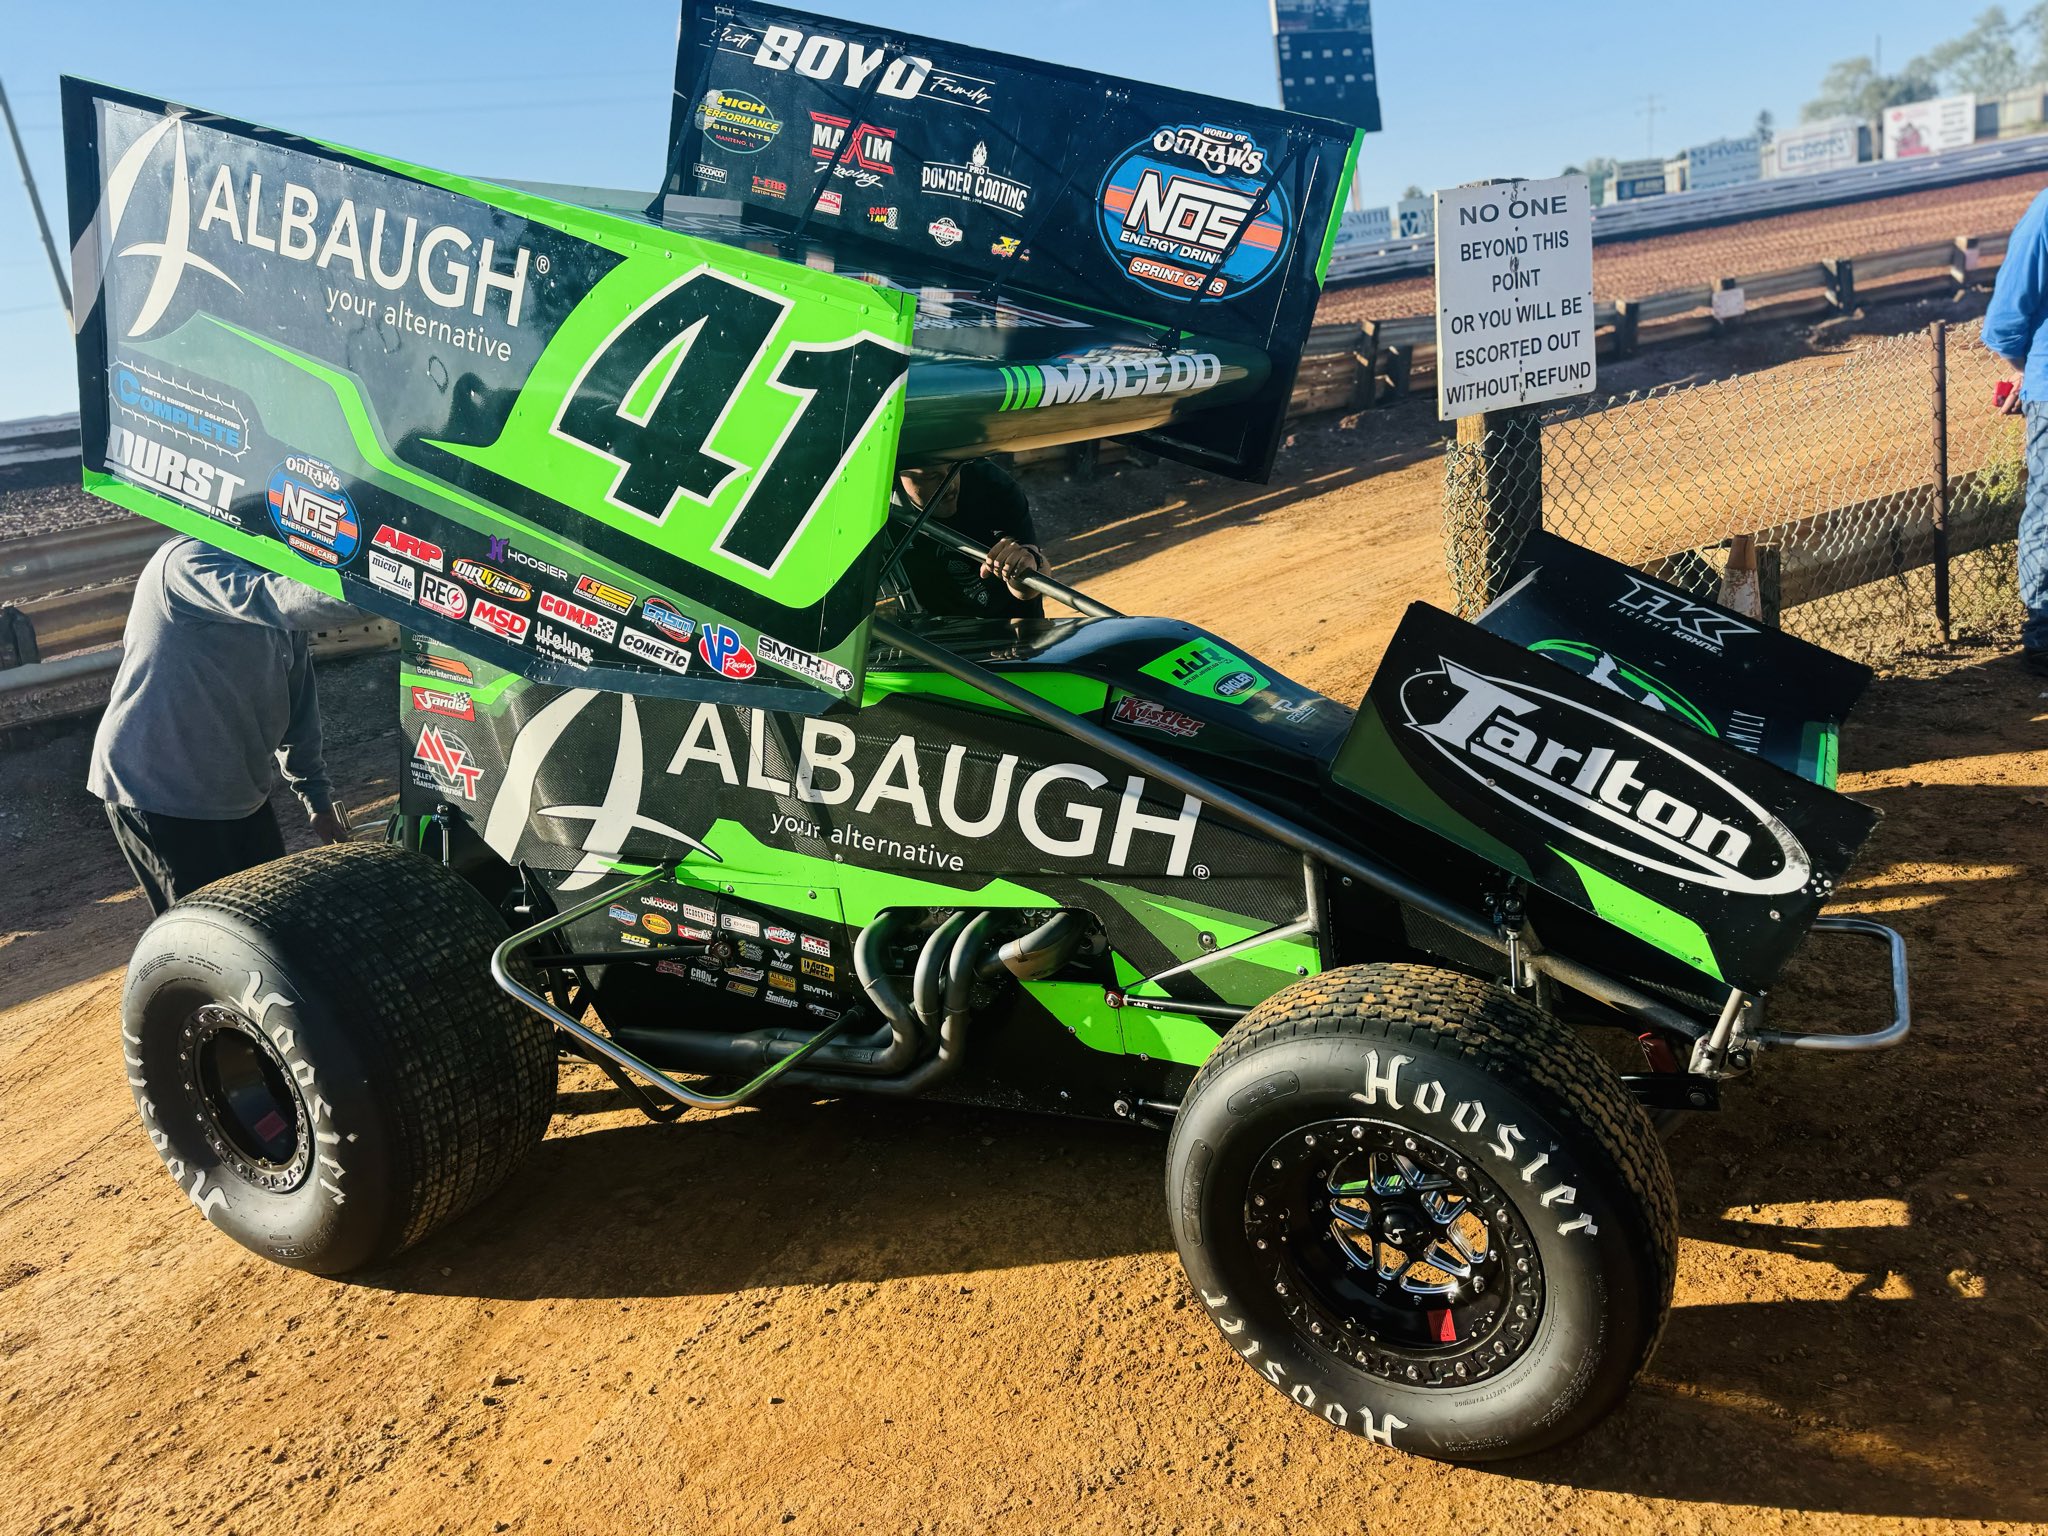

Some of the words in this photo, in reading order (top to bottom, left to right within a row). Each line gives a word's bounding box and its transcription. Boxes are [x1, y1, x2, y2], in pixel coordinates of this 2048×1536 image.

[717, 95, 766, 115] HIGH
[930, 76, 991, 105] Family
[697, 105, 779, 132] PERFORMANCE
[1203, 127, 1233, 140] WORLD
[1234, 134, 1248, 143] OF
[811, 120, 894, 168] MAXIM
[969, 165, 985, 175] PRO
[922, 166, 972, 195] POWDER
[974, 175, 1027, 211] COATING
[869, 206, 888, 216] SAM
[1124, 171, 1268, 250] NOS
[1459, 203, 1499, 226] NO
[1508, 195, 1568, 220] ONE
[199, 163, 530, 328] ALBAUGH
[1120, 230, 1180, 255] ENERGY
[1460, 236, 1528, 262] BEYOND
[1533, 230, 1569, 250] THIS
[1131, 260, 1184, 283] SPRINT
[1183, 274, 1224, 293] CAS
[1492, 268, 1541, 293] POINT
[326, 282, 379, 321] your
[384, 301, 512, 363] alternative
[1451, 314, 1475, 335] OR
[1478, 308, 1511, 330] YOU
[1516, 301, 1556, 324] WILL
[1561, 297, 1582, 316] BE
[1455, 337, 1542, 369] ESCORTED
[1547, 330, 1581, 352] OUT
[1038, 353, 1222, 408] MACEDO
[1447, 374, 1520, 405] WITHOUT
[1525, 361, 1591, 390] REFUND
[117, 369, 240, 448] COMPLETE
[141, 386, 161, 400] PARTS
[166, 396, 203, 416] EQUIPMENT
[204, 410, 241, 430] SOLUTIONS
[549, 263, 912, 579] 41
[285, 457, 341, 491] OUTLAWS
[210, 505, 242, 526] INC
[281, 482, 348, 537] NOS
[280, 518, 310, 536] ENERGY
[310, 530, 335, 547] DRINK
[373, 525, 443, 563] ARP
[289, 535, 317, 556] SPRINT
[316, 548, 338, 564] CARS
[507, 549, 569, 582] HOOSIER
[575, 588, 593, 600] RACING
[474, 600, 527, 634] MSD
[540, 594, 599, 629] COMP
[580, 623, 608, 639] CAMS
[1608, 603, 1671, 631] FACTORY
[1671, 629, 1724, 654] KAHNE
[623, 634, 687, 668] COMETIC
[702, 623, 742, 673] VP
[725, 657, 757, 674] Racing
[758, 649, 790, 668] BRAKE
[791, 662, 833, 685] SYSTEMS
[1217, 672, 1254, 696] ENGLER
[1116, 697, 1206, 732] Kistler
[410, 761, 436, 774] MESILLA
[411, 770, 433, 781] VALLEY
[1404, 655, 1753, 869] Tarlton
[412, 778, 463, 797] TRANSPORTATION
[665, 702, 1203, 877] ALBAUGH
[768, 808, 821, 836] your
[829, 823, 966, 872] alternative
[641, 896, 678, 912] wilwood
[691, 968, 712, 983] CRON
[770, 960, 794, 972] WALKER
[811, 962, 830, 972] Auto
[765, 990, 799, 1009] Smiley's
[1350, 1048, 1599, 1236] Hoosier
